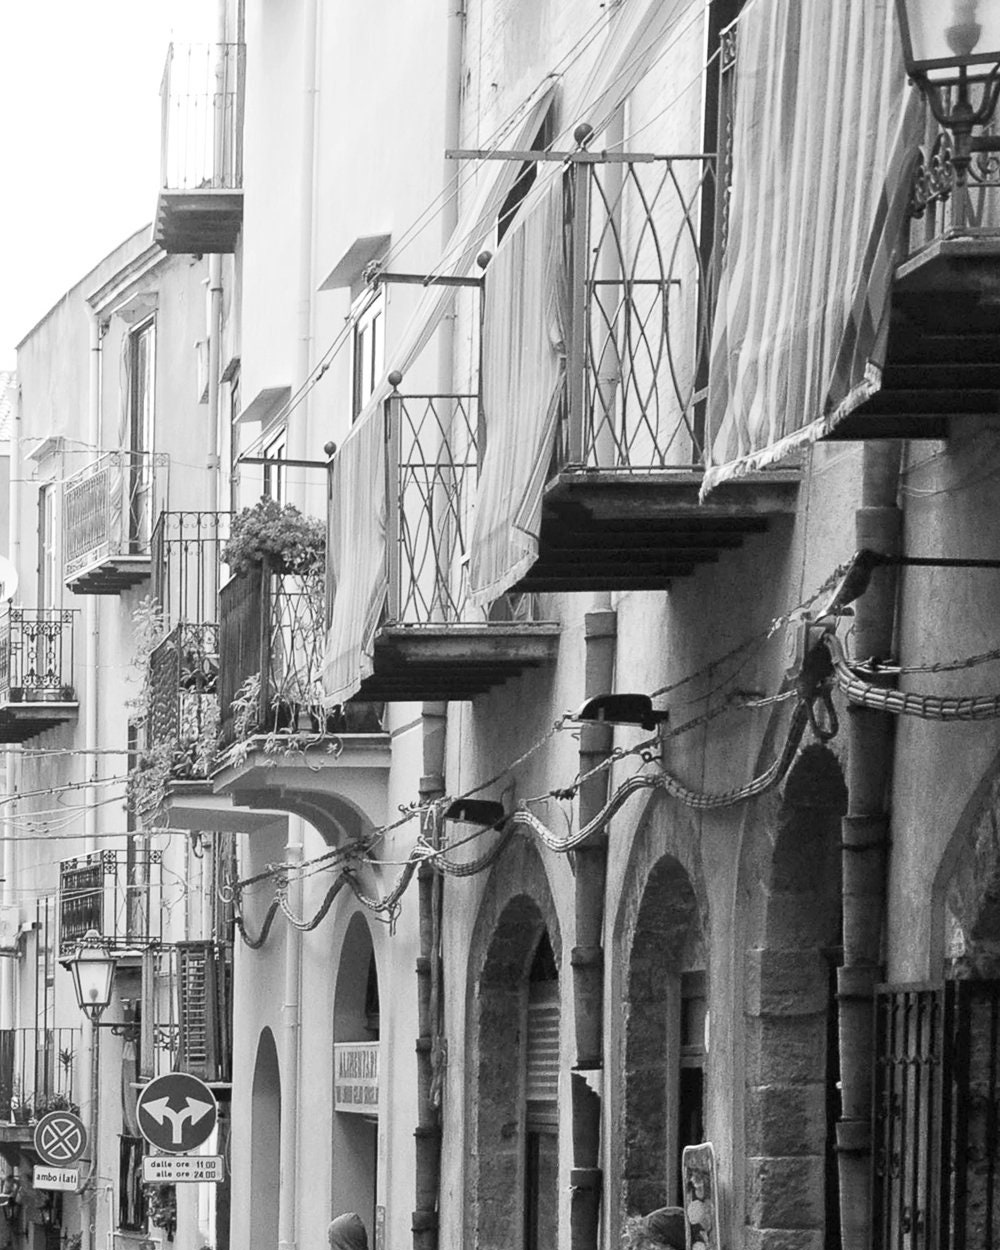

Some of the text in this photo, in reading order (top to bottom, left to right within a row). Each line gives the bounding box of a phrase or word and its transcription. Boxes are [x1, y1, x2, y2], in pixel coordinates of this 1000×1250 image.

[36, 1172, 58, 1182] ambo
[62, 1173, 77, 1183] lati
[156, 1170, 172, 1178] alle
